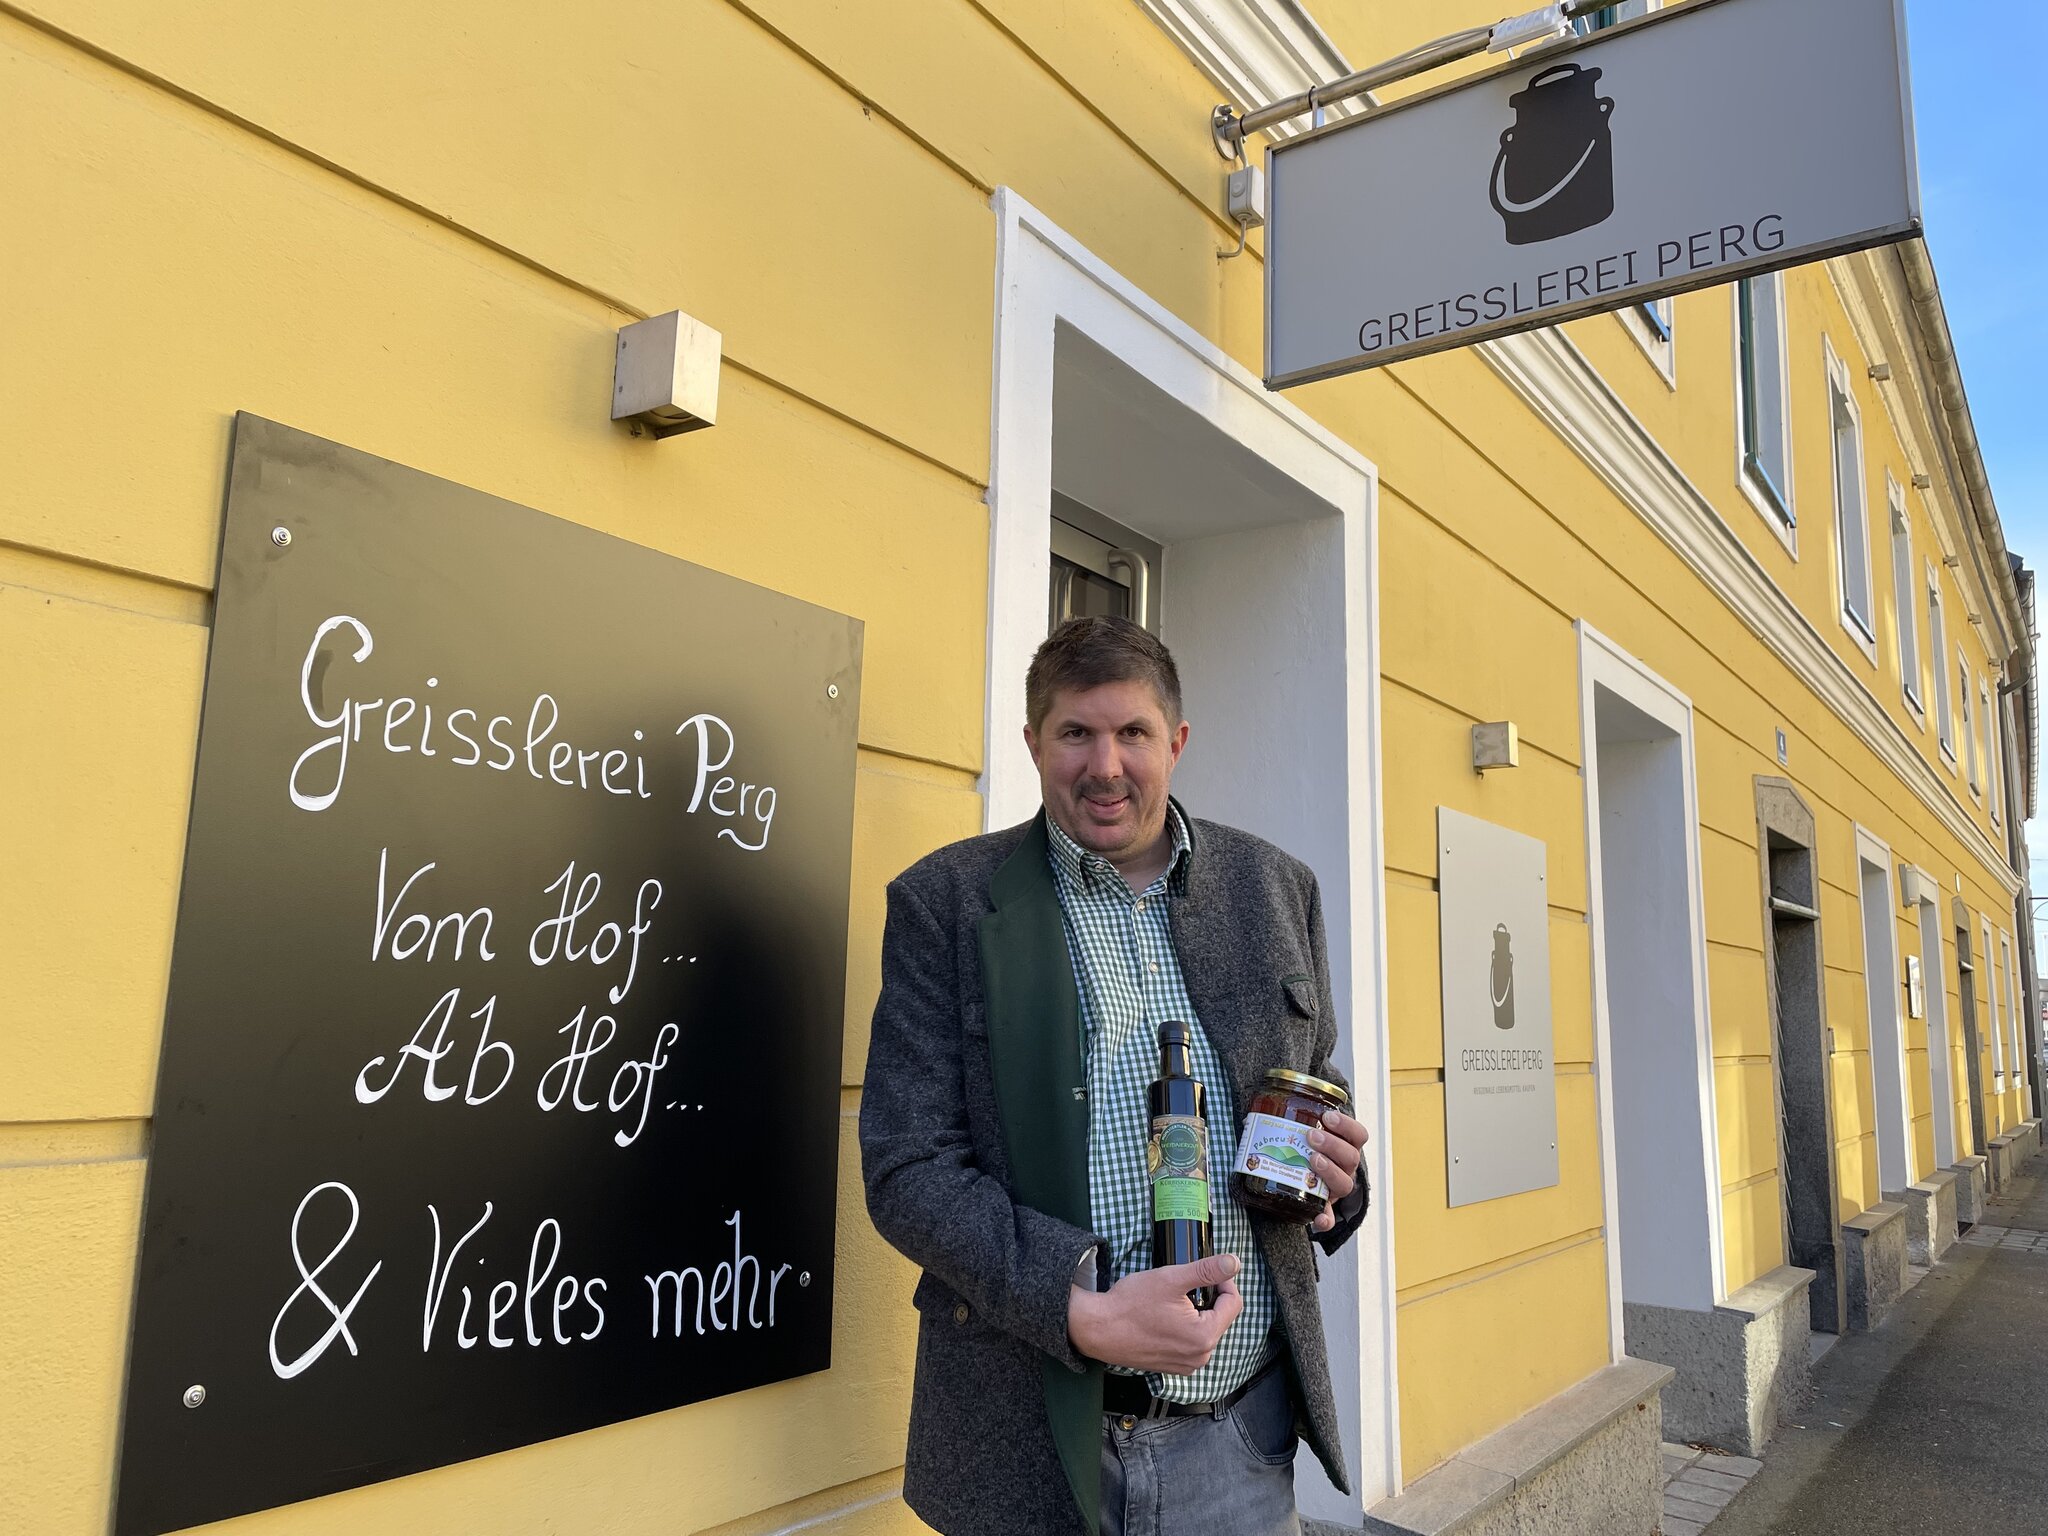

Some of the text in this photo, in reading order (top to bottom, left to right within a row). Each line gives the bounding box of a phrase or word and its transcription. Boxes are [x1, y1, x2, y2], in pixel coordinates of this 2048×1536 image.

[1358, 213, 1785, 352] GREISSLEREI PERG
[289, 614, 777, 851] Greisslerei Perg
[372, 847, 496, 963] Vom
[354, 988, 516, 1105] Ab
[1461, 1049, 1543, 1072] GREISSLEREI PERG
[269, 1181, 793, 1379] & Vieles mehr
